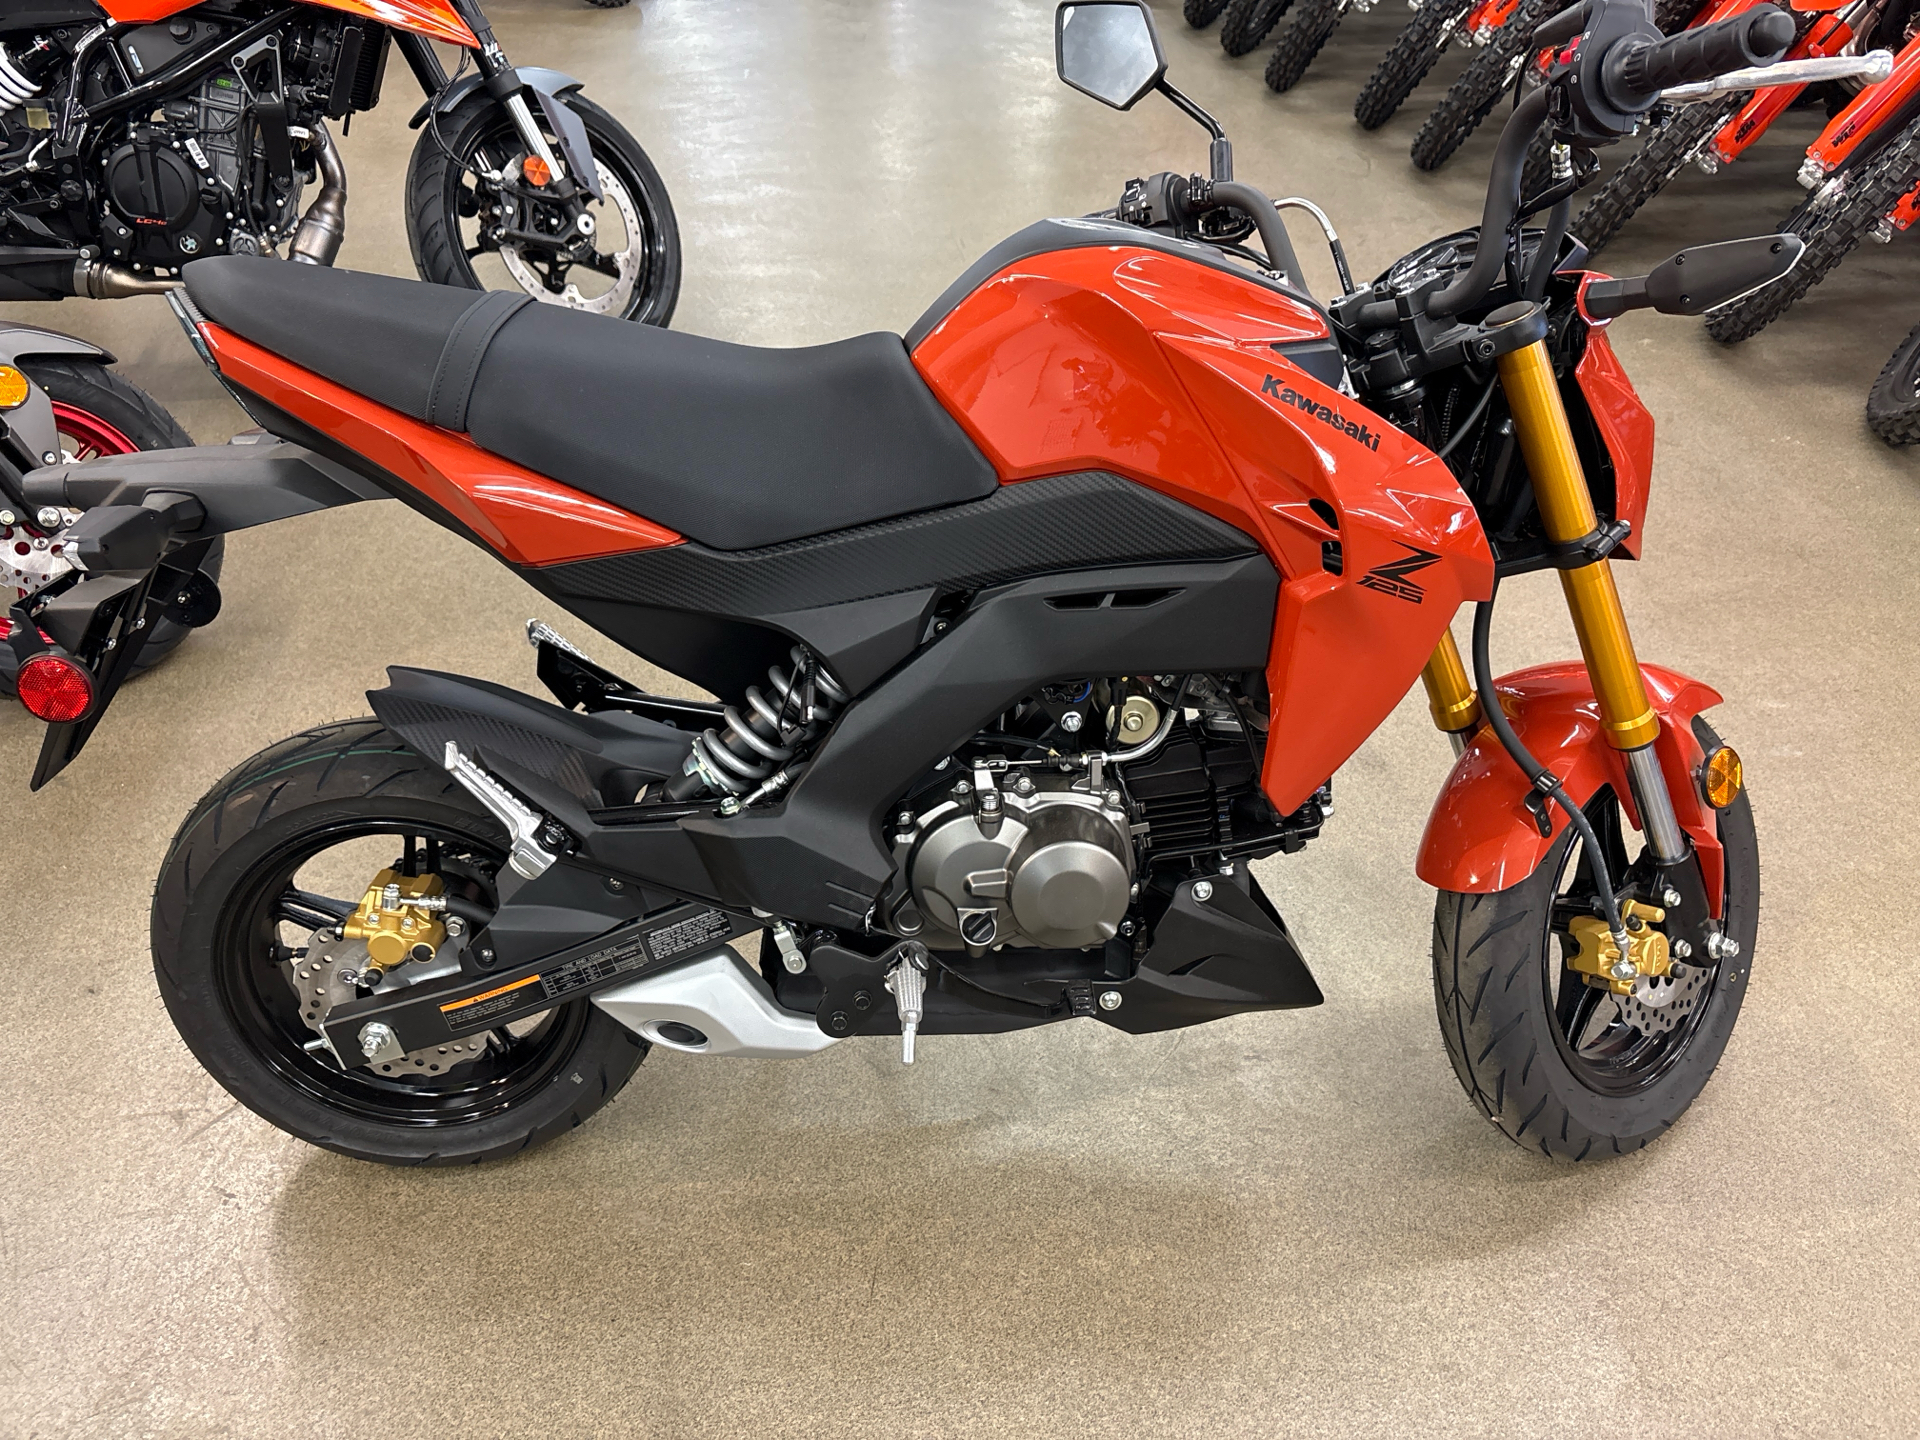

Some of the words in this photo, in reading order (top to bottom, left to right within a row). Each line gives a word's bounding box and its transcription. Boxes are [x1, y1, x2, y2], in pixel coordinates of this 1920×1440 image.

[1261, 374, 1381, 452] Kawasaki
[1368, 540, 1443, 591] Z
[1356, 575, 1424, 604] 125
[479, 987, 508, 1000] WARNING
